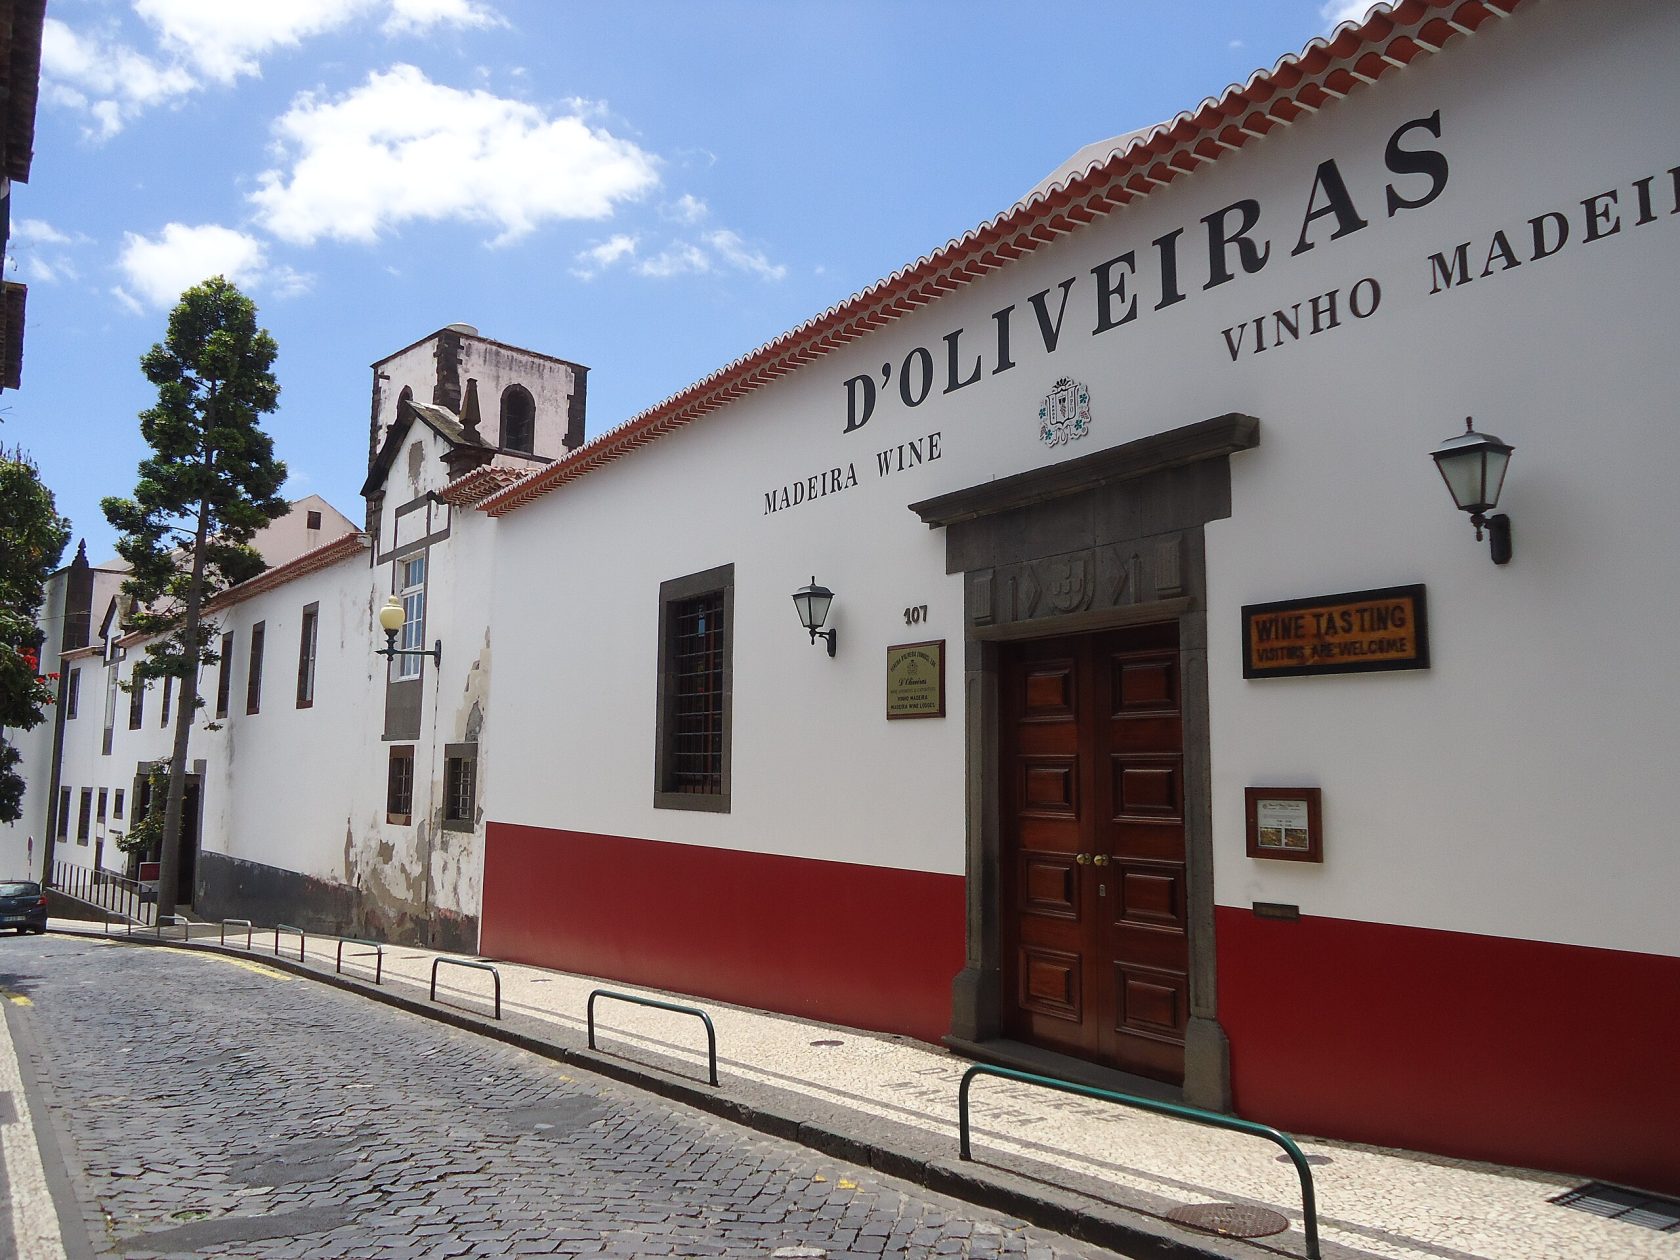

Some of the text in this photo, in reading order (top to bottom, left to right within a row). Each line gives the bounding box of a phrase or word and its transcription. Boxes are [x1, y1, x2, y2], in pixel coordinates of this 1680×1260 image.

[842, 109, 1450, 434] D'OLIVEIRAS
[1221, 277, 1381, 362] VINHO
[763, 431, 942, 516] MADEIRA WINE
[903, 604, 928, 625] 107
[1256, 605, 1406, 642] WINE TASTING
[1337, 637, 1407, 656] WELCOME
